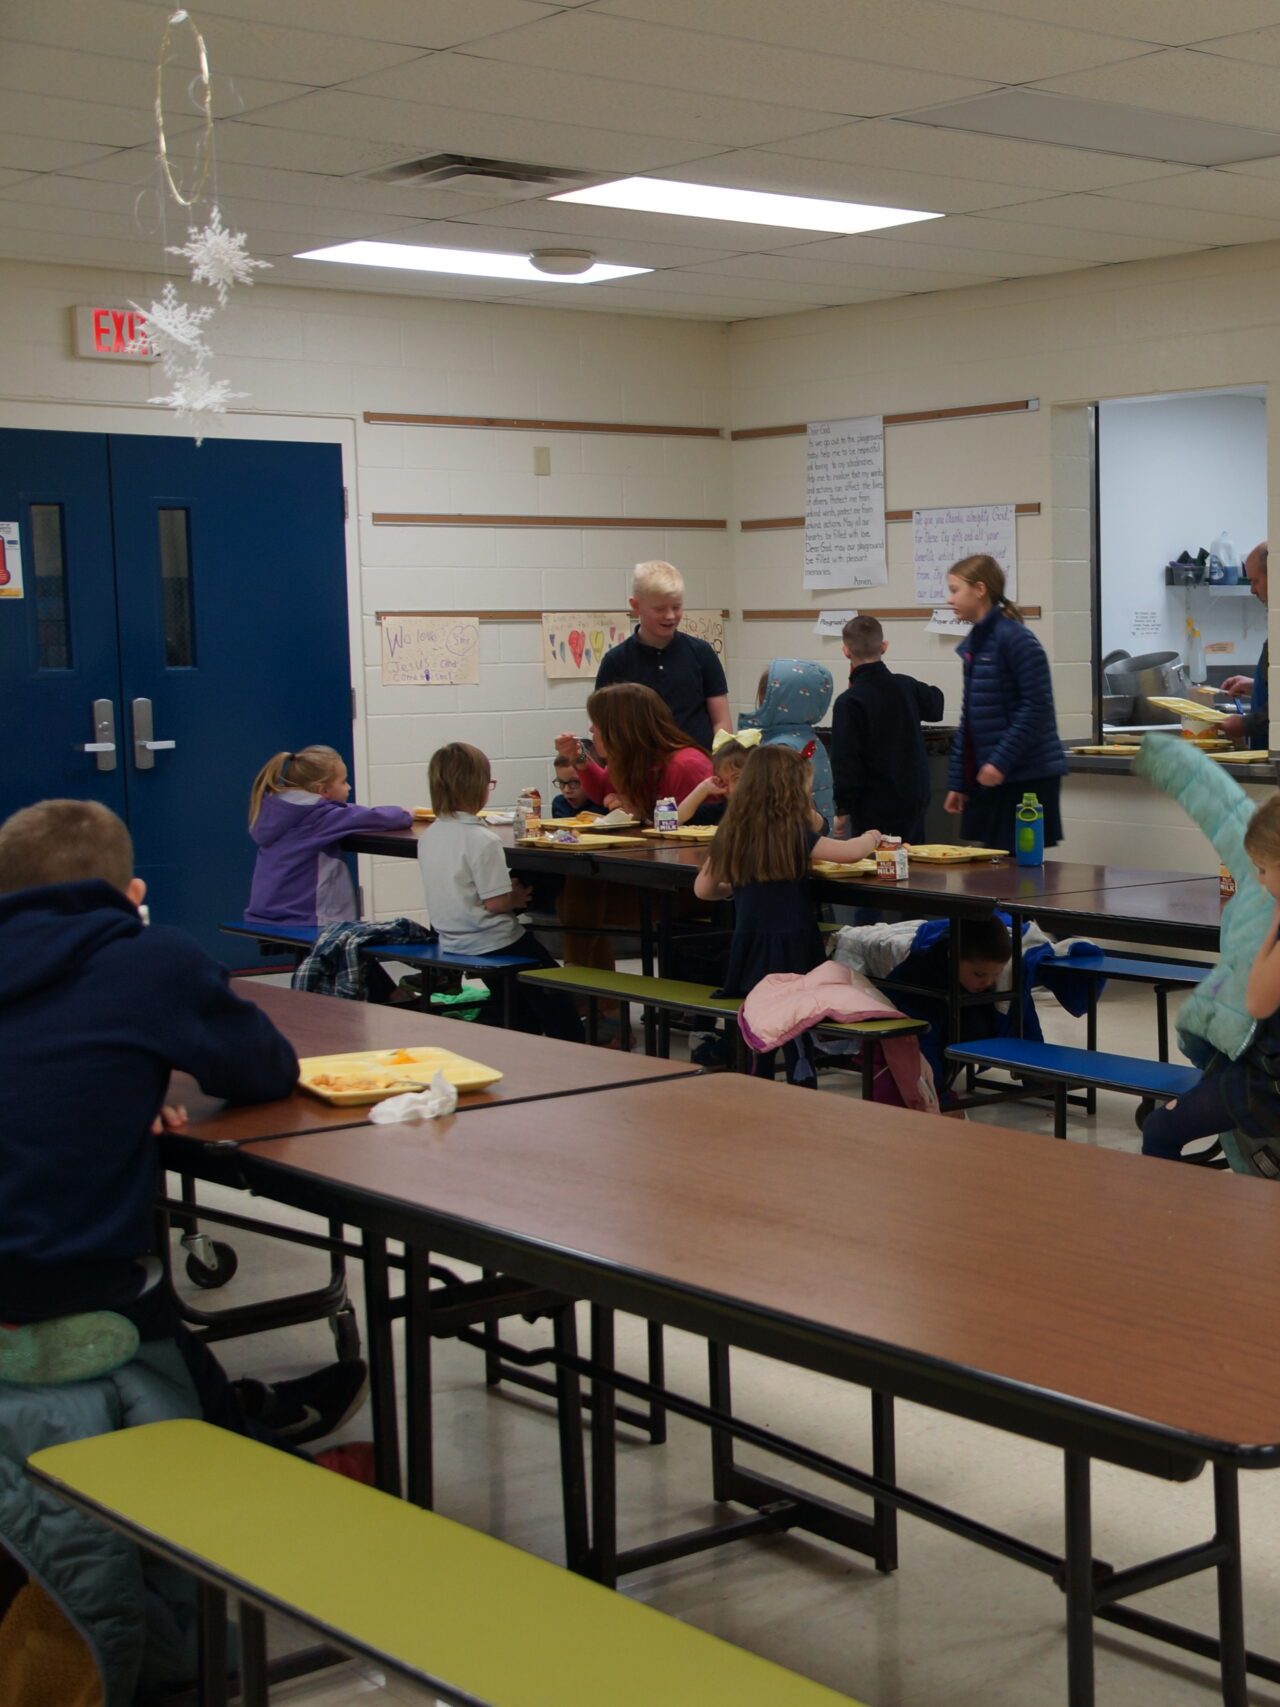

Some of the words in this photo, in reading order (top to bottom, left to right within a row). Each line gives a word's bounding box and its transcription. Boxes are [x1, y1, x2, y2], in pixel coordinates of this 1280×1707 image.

[416, 628, 437, 643] love
[389, 657, 430, 673] Jesus
[1220, 883, 1235, 891] MILK
